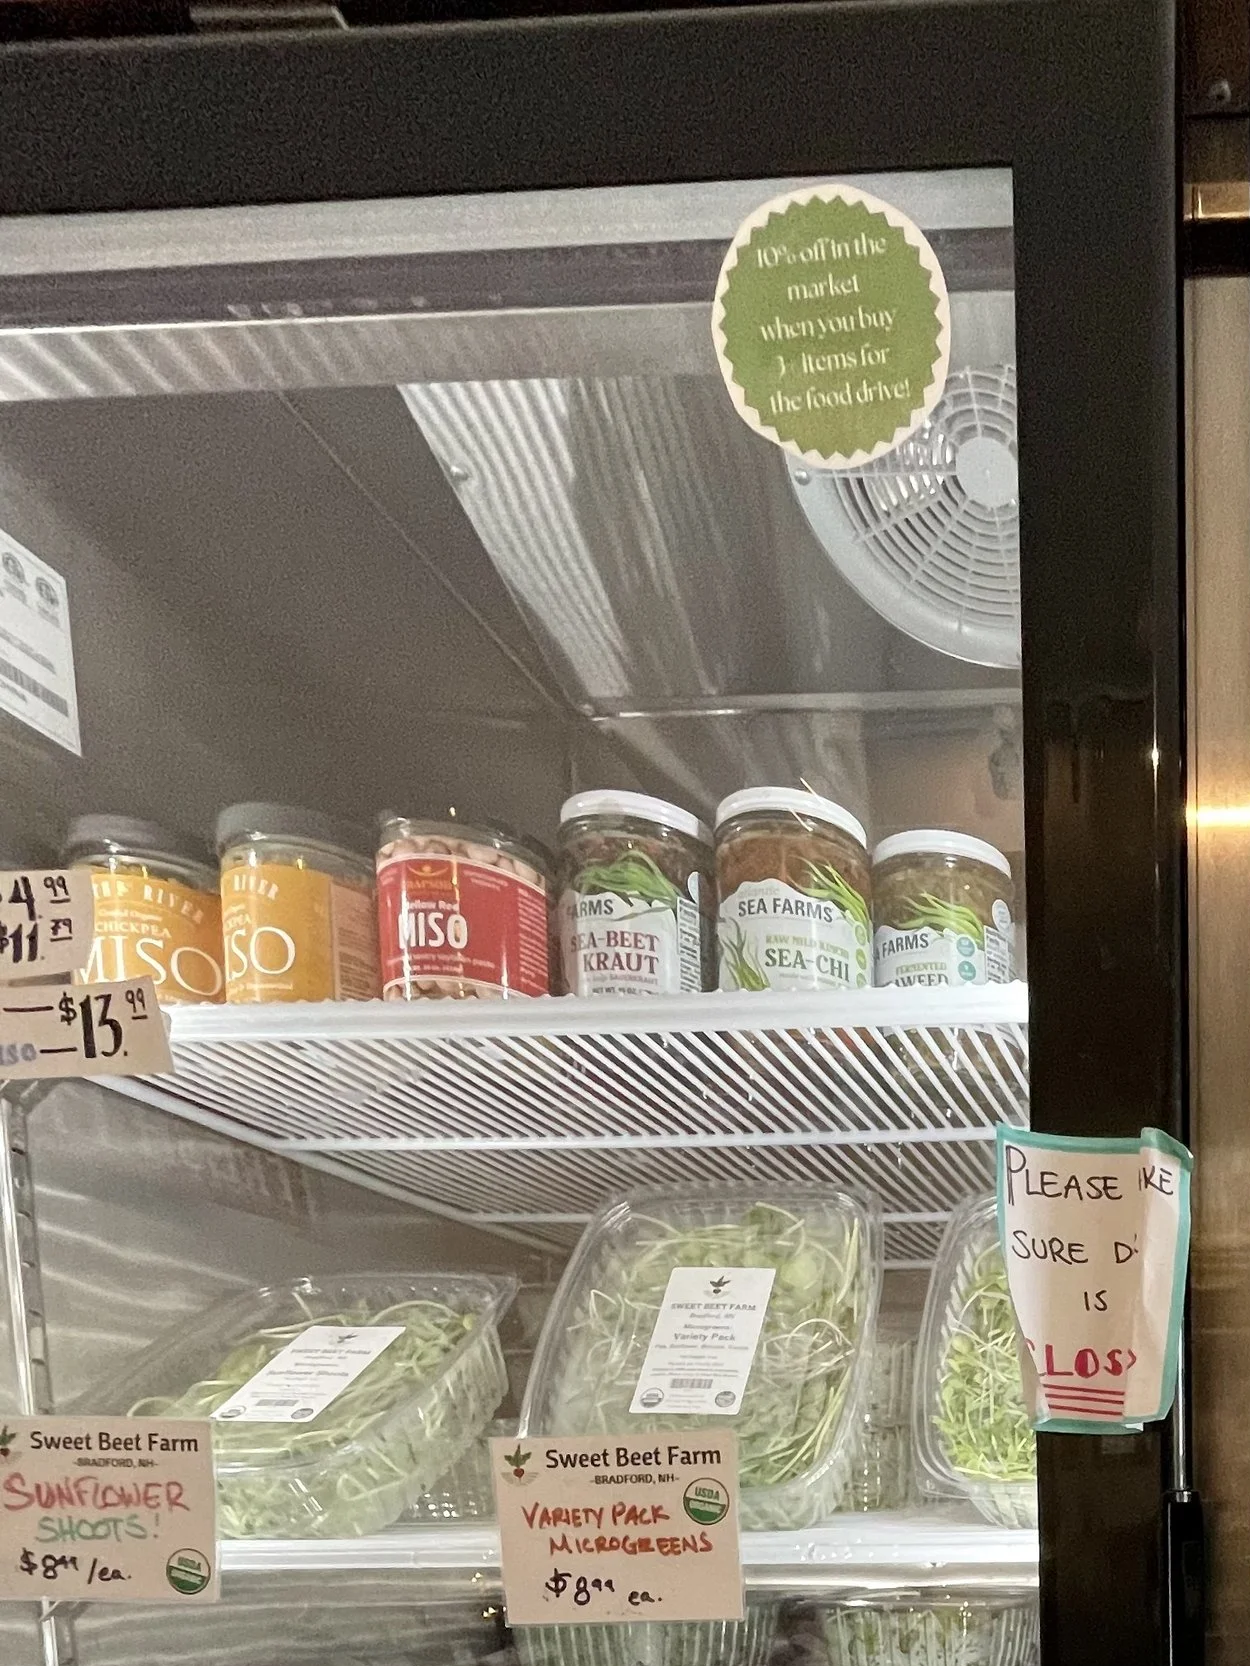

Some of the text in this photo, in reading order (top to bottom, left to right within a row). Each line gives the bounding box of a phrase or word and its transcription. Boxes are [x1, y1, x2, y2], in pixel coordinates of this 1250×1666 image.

[800, 238, 830, 263] off
[855, 233, 887, 256] the
[788, 273, 859, 302] market
[760, 306, 897, 343] when you buy
[802, 344, 891, 374] items for
[770, 378, 911, 415] the food drive!
[144, 885, 204, 923] RIVER
[739, 898, 832, 922] SEA FARMS
[398, 912, 468, 949] MISO
[570, 930, 660, 952] SEA-BEET
[766, 935, 789, 945] RAW
[883, 933, 929, 959] FARMS
[583, 952, 659, 974] KRAUT
[765, 948, 849, 982] SEA-CHI
[1005, 1144, 1123, 1205] PLEASE
[1011, 1230, 1089, 1265] SURE
[1084, 1290, 1109, 1311] IS
[674, 1333, 736, 1341] Variety Pack
[30, 1431, 198, 1452] Sweet Beet Farm
[546, 1446, 722, 1469] Sweet Beet Farm
[3, 1472, 191, 1512] SUNFLOWER
[522, 1502, 670, 1530] VARIETY PACK
[549, 1531, 713, 1555] MICROGREENS
[628, 1591, 662, 1606] ea.
